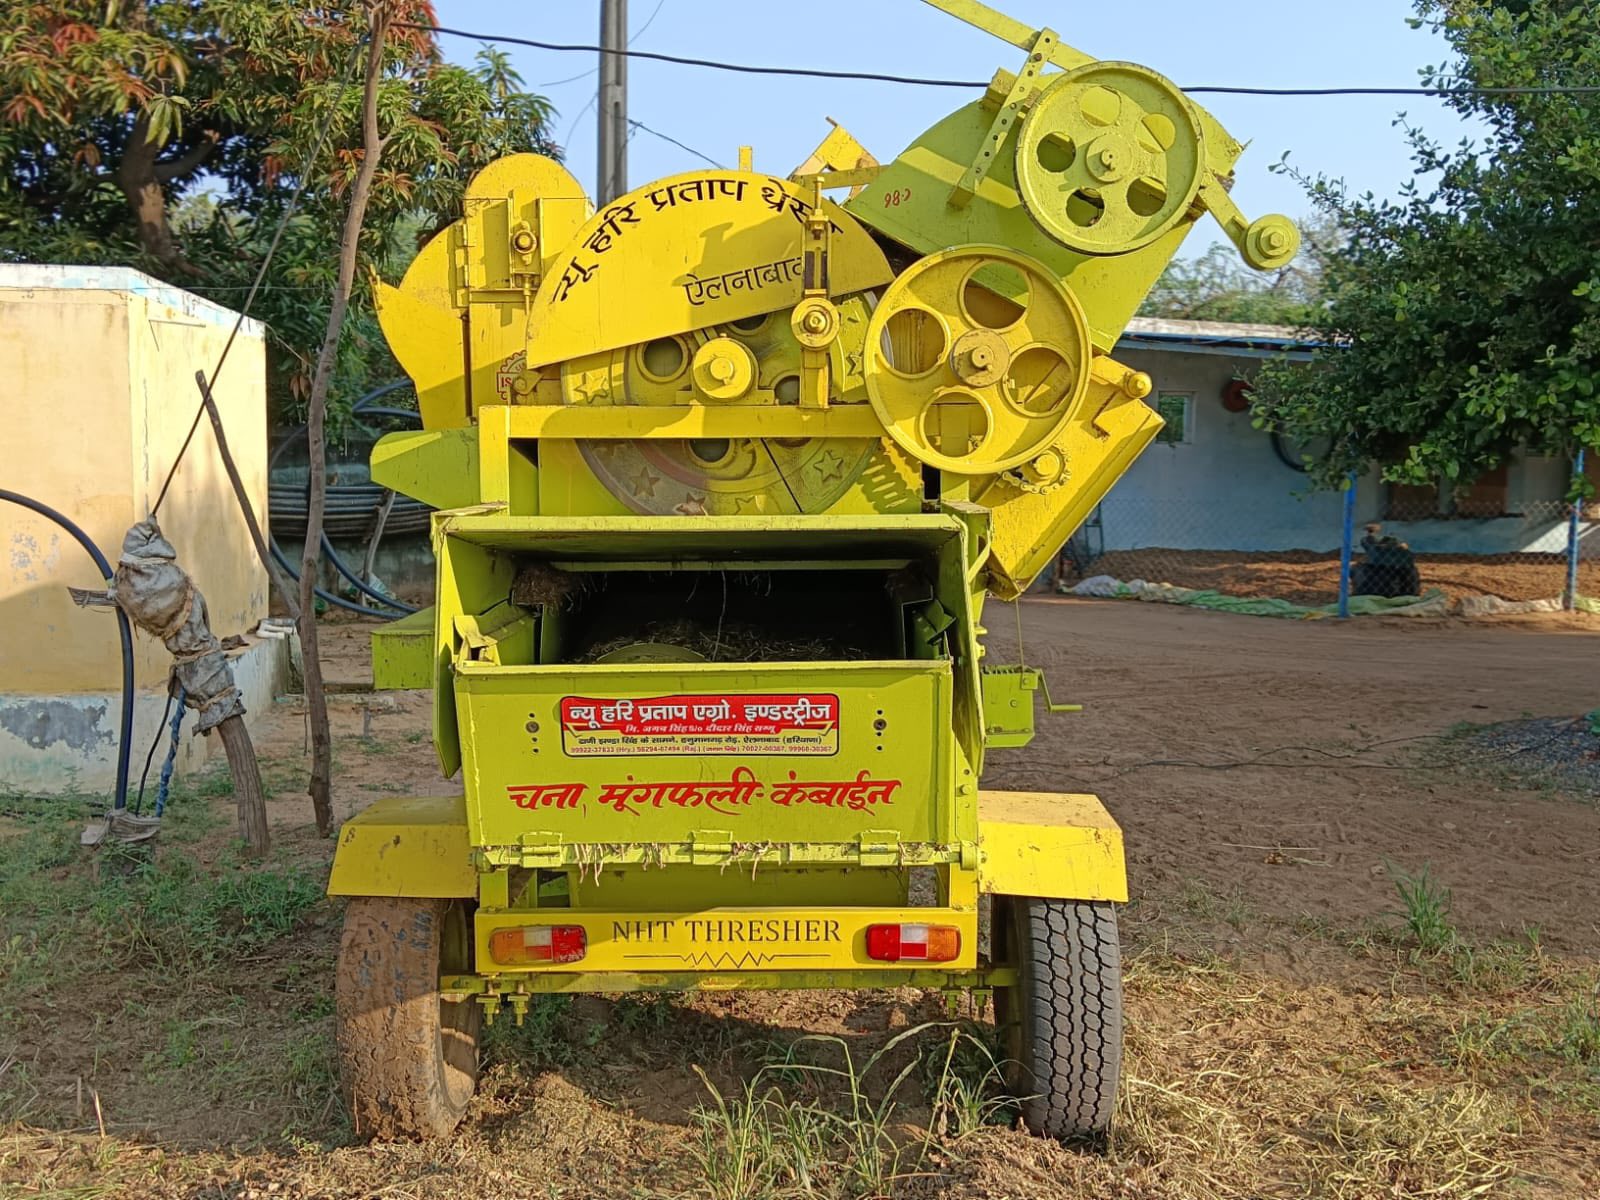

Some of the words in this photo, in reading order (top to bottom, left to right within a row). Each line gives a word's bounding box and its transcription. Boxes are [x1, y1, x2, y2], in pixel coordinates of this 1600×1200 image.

[582, 200, 641, 254] हरि
[644, 178, 748, 212] प्रताप
[569, 704, 602, 729] न्यू
[601, 699, 633, 722] हरि
[637, 705, 687, 723] प्रताप
[744, 697, 831, 726] इण्डस्ट्रीज
[612, 920, 674, 943] NHT
[685, 919, 842, 943] THRESHER
